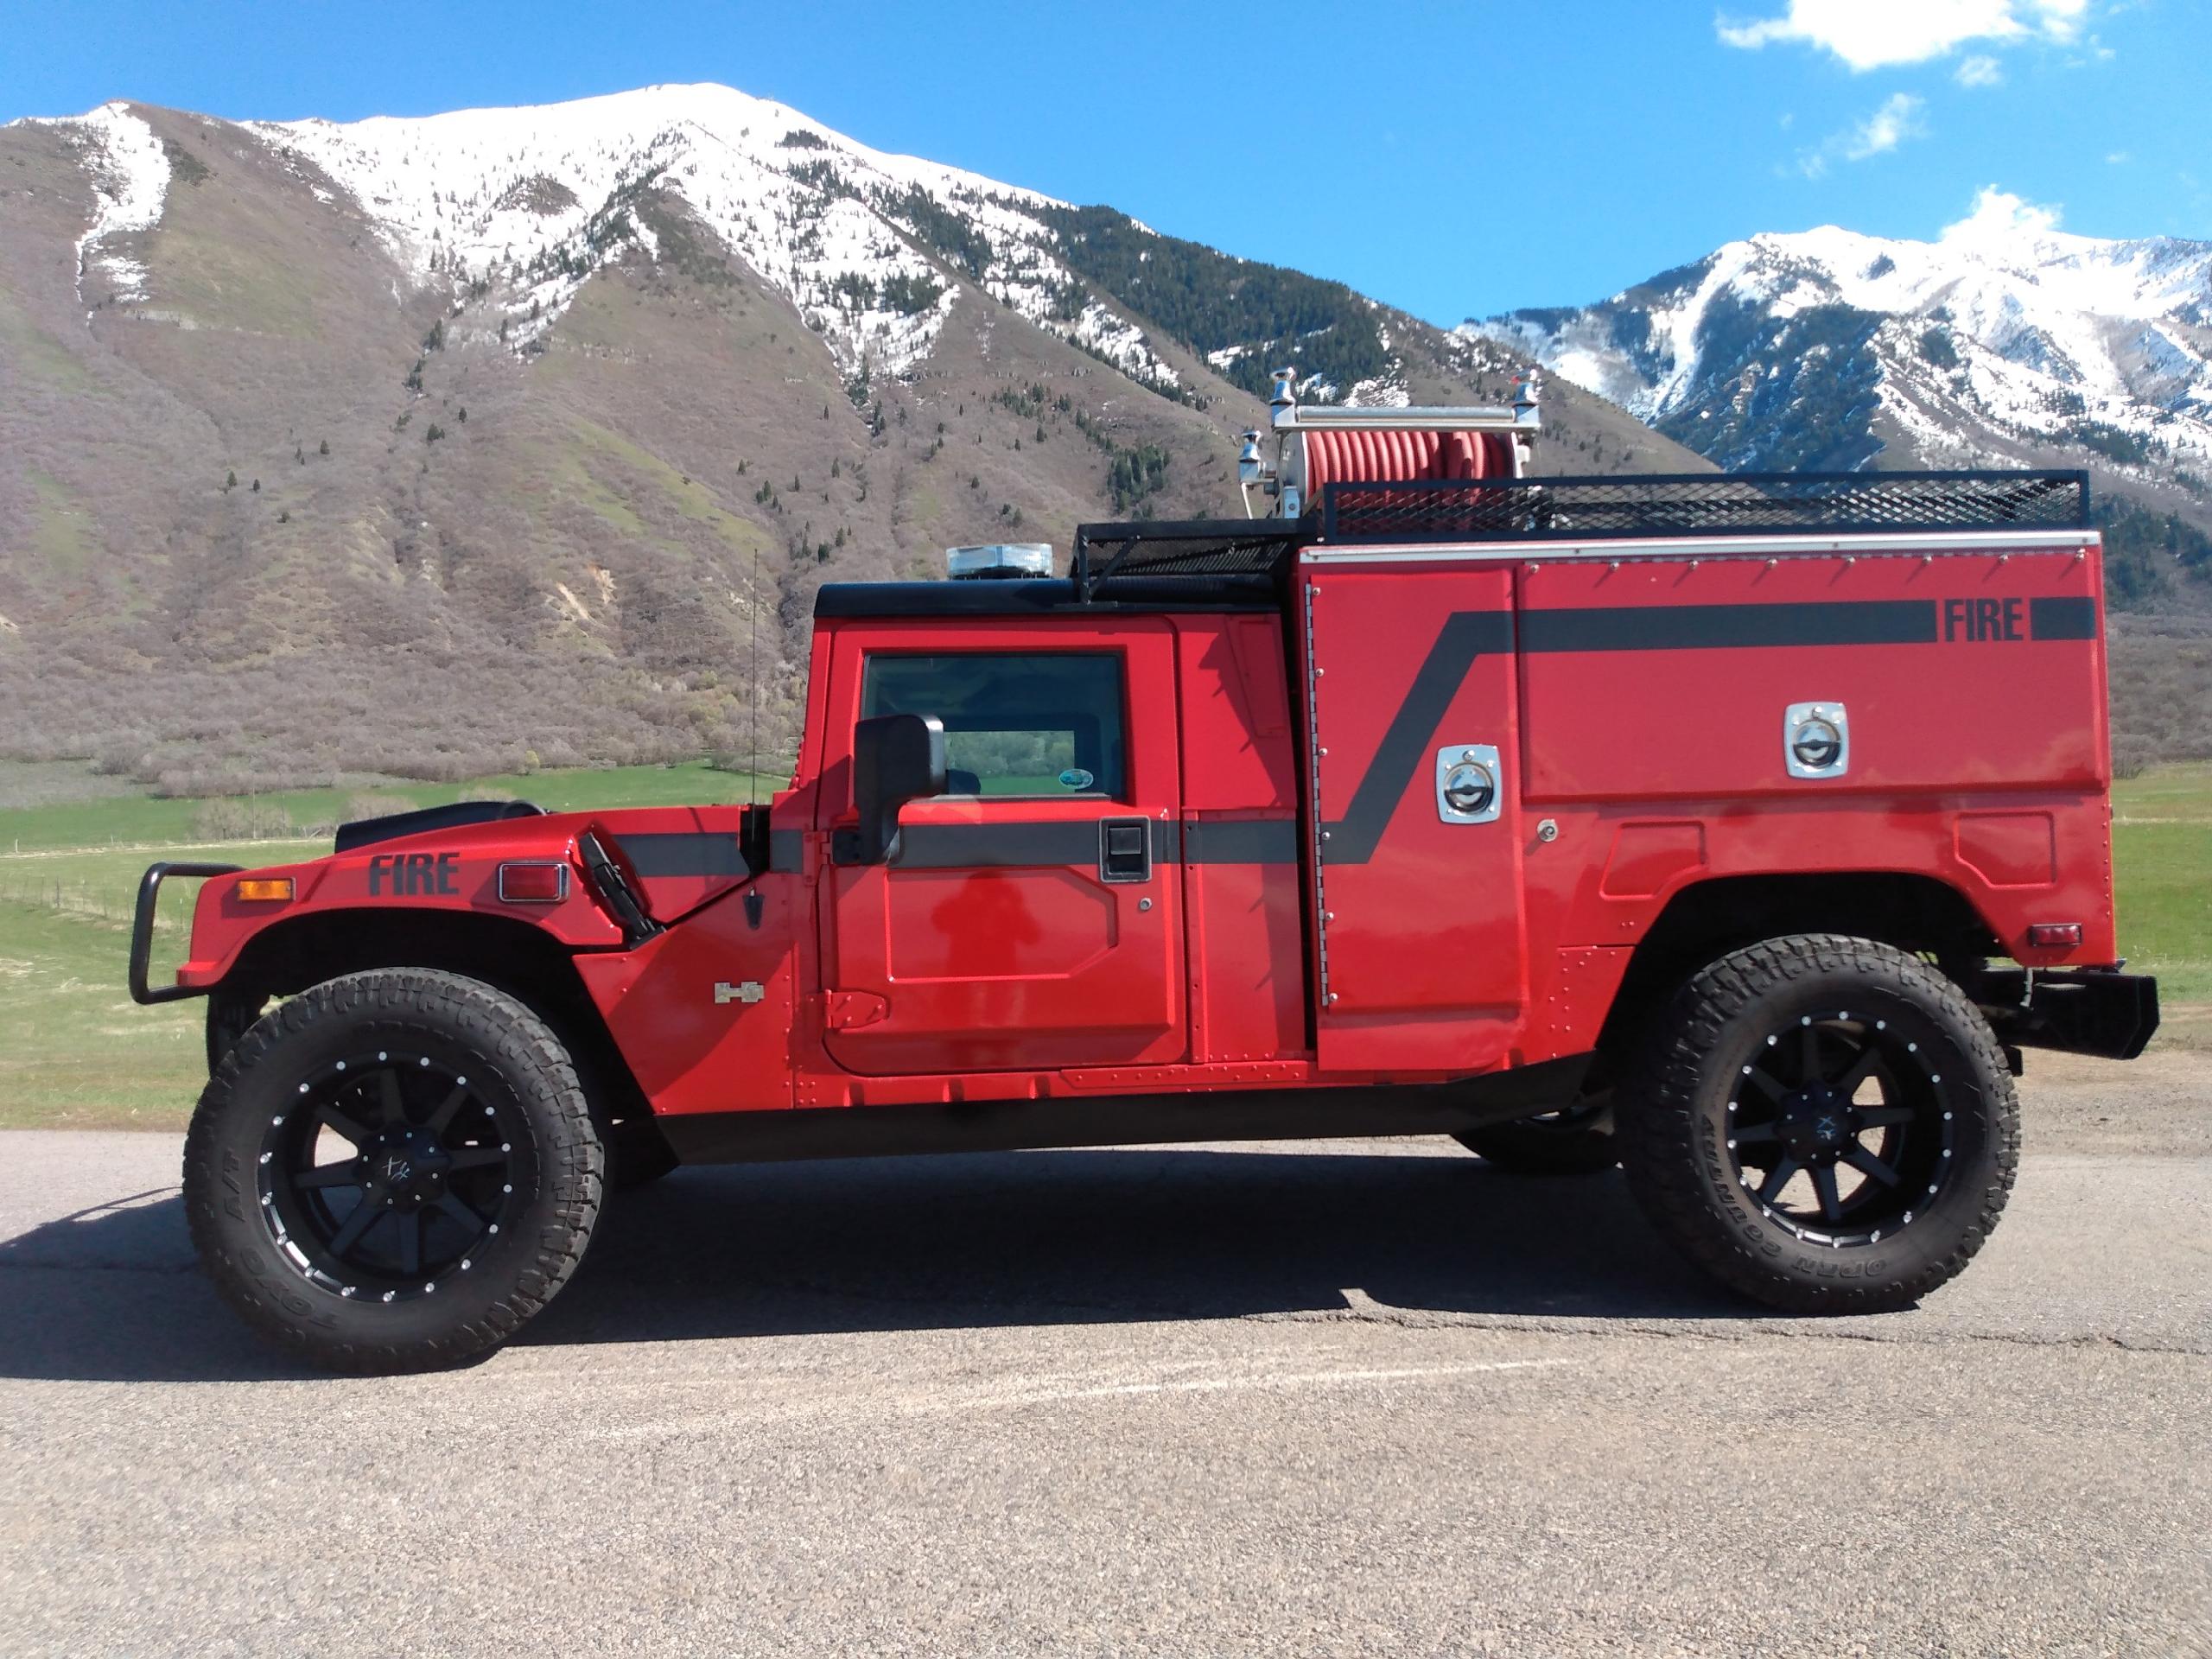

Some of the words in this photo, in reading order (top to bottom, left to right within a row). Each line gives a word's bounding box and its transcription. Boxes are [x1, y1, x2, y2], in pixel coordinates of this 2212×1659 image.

[1945, 598, 2024, 642] FIRE
[368, 852, 460, 897] FIRE
[239, 1246, 341, 1330] TOYO
[1790, 1256, 1888, 1279] OPEN
